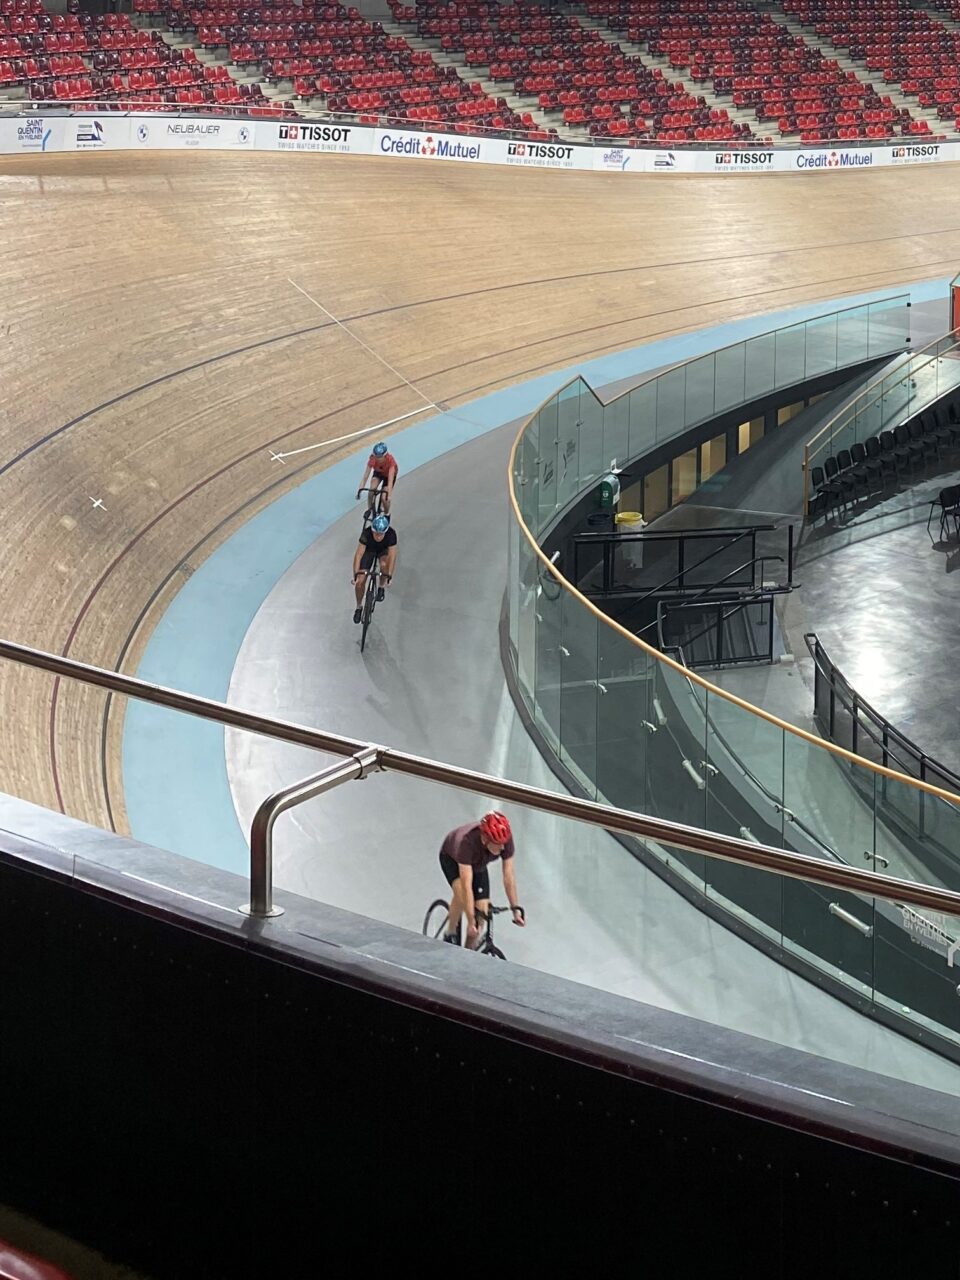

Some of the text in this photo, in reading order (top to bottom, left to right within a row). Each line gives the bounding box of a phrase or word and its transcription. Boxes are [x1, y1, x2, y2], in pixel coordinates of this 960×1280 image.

[26, 119, 44, 127] SAINT
[17, 127, 43, 135] QUENTIN
[167, 124, 221, 134] NEUBAUER
[300, 126, 351, 142] TISSOT
[380, 135, 481, 159] Crédit Mutuel
[527, 144, 574, 159] TISSOT
[906, 146, 940, 157] TISSOT
[733, 153, 774, 164] TISSOT
[796, 152, 873, 168] Crédit Mutuel
